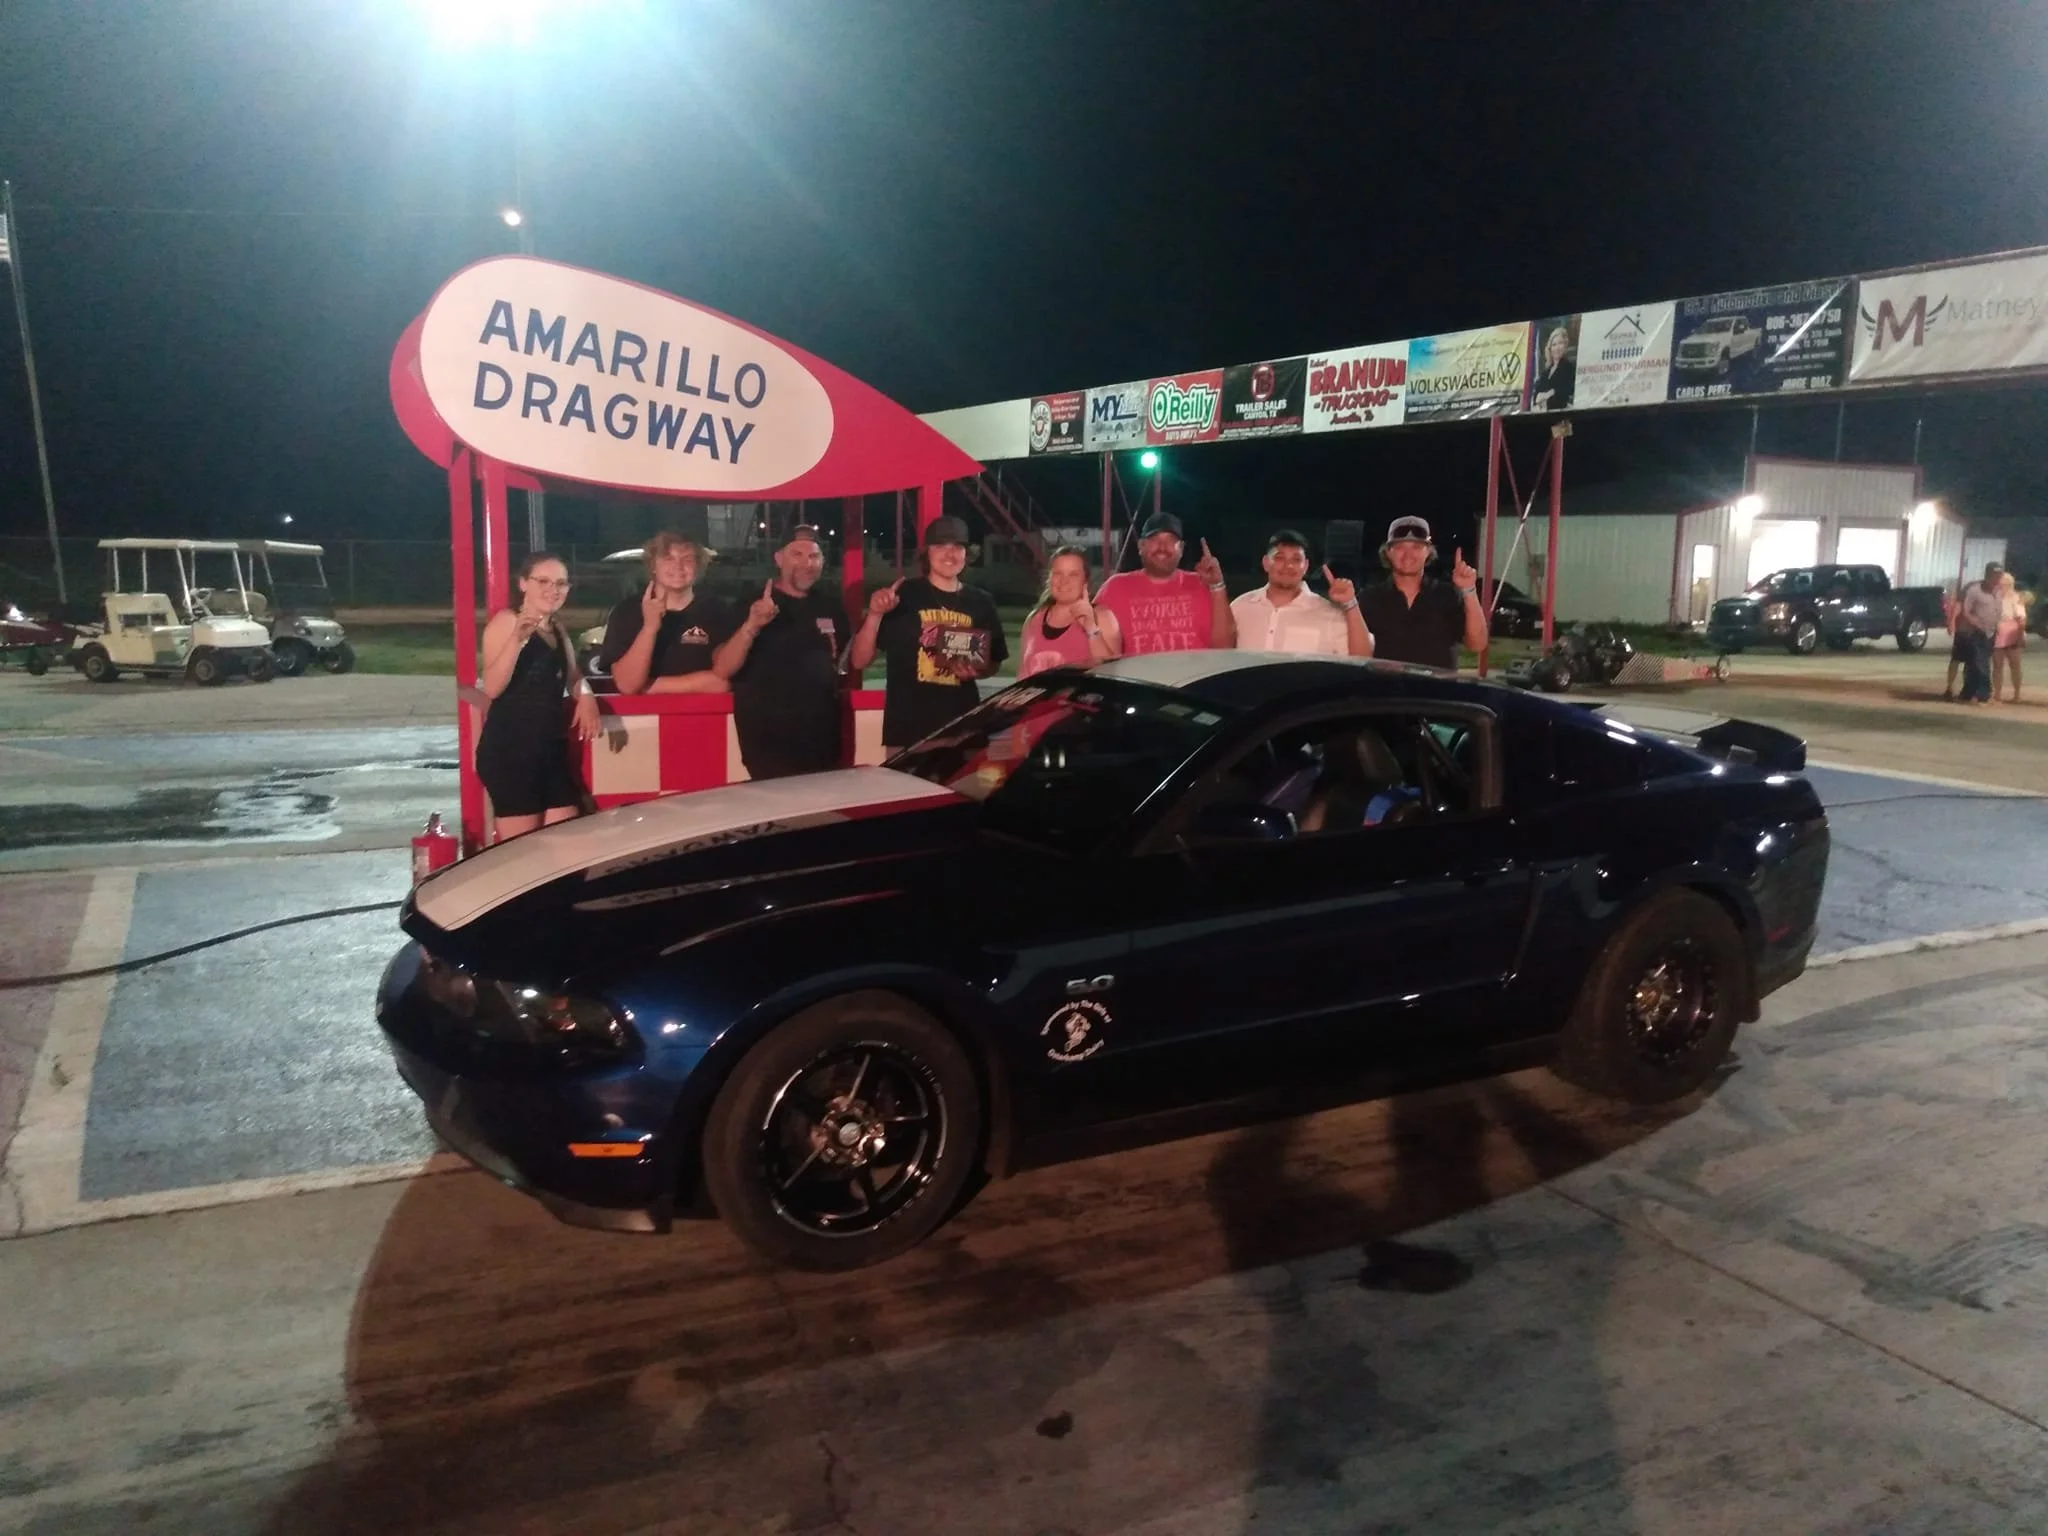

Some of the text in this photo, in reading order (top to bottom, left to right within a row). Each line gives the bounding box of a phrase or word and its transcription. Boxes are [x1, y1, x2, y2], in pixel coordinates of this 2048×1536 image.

[1947, 298, 2041, 323] Matney
[479, 299, 767, 408] AMARILLO
[1310, 357, 1406, 396] BRANUM
[1410, 371, 1495, 395] VOLKSWAGEN
[1676, 383, 1732, 399] CARLOS PEREZ
[473, 360, 756, 465] DRAGWAY
[1153, 386, 1219, 429] O'Reilly
[1235, 399, 1287, 414] TRAILER SALES
